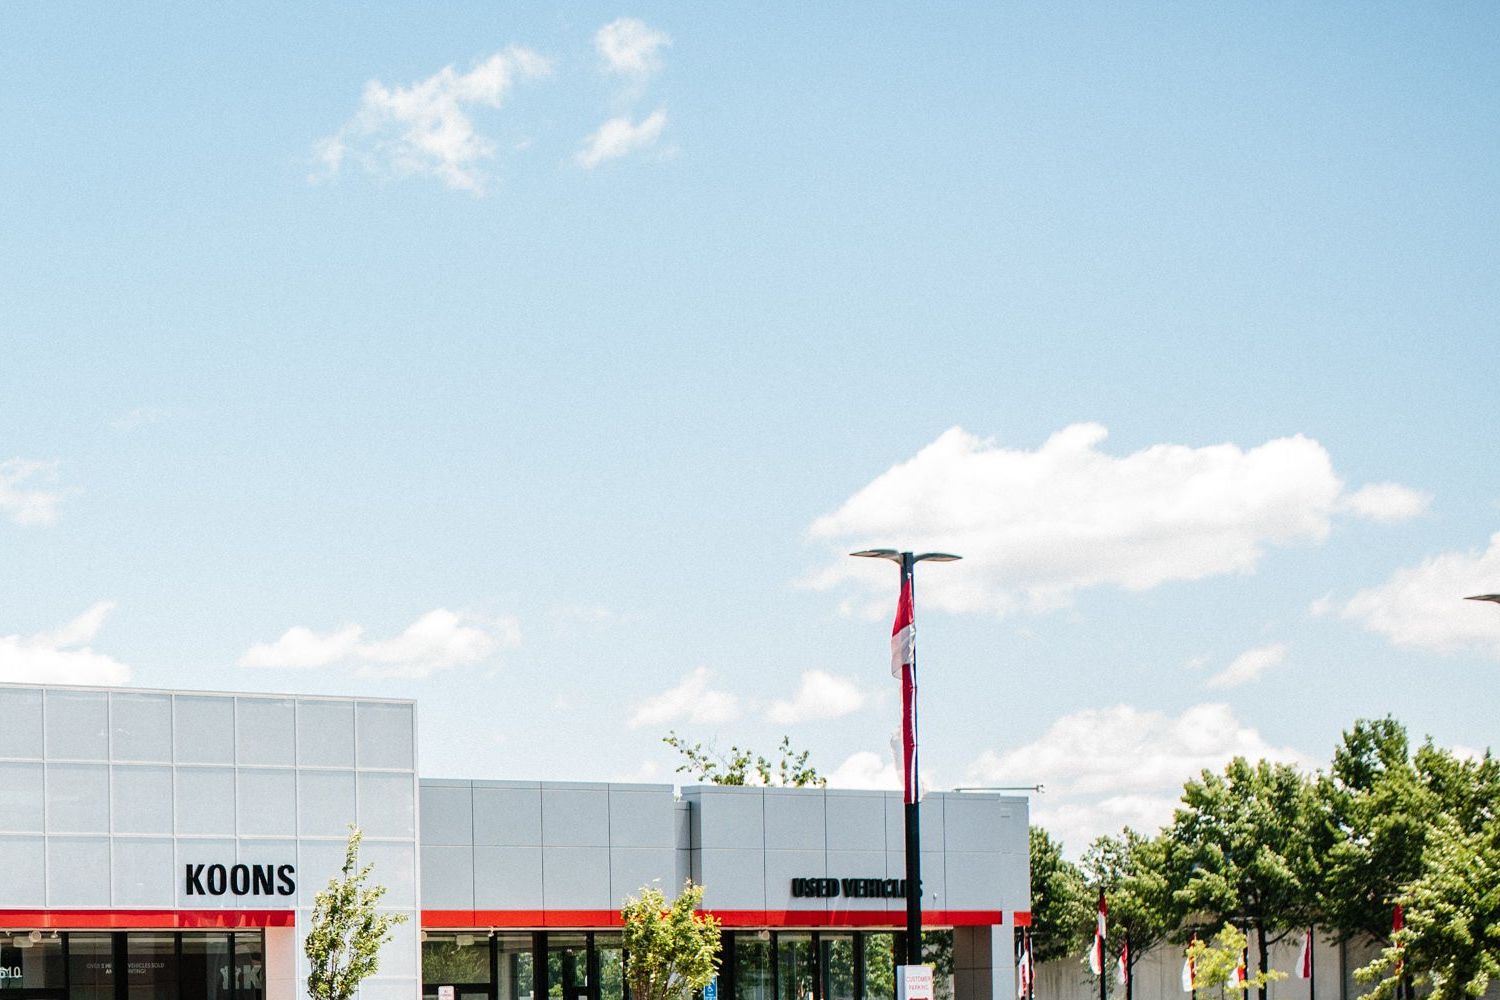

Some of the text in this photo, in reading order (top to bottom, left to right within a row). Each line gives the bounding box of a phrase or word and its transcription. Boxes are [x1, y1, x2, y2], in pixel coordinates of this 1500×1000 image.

[185, 863, 296, 896] KOONS
[791, 877, 923, 898] USED VEHICL
